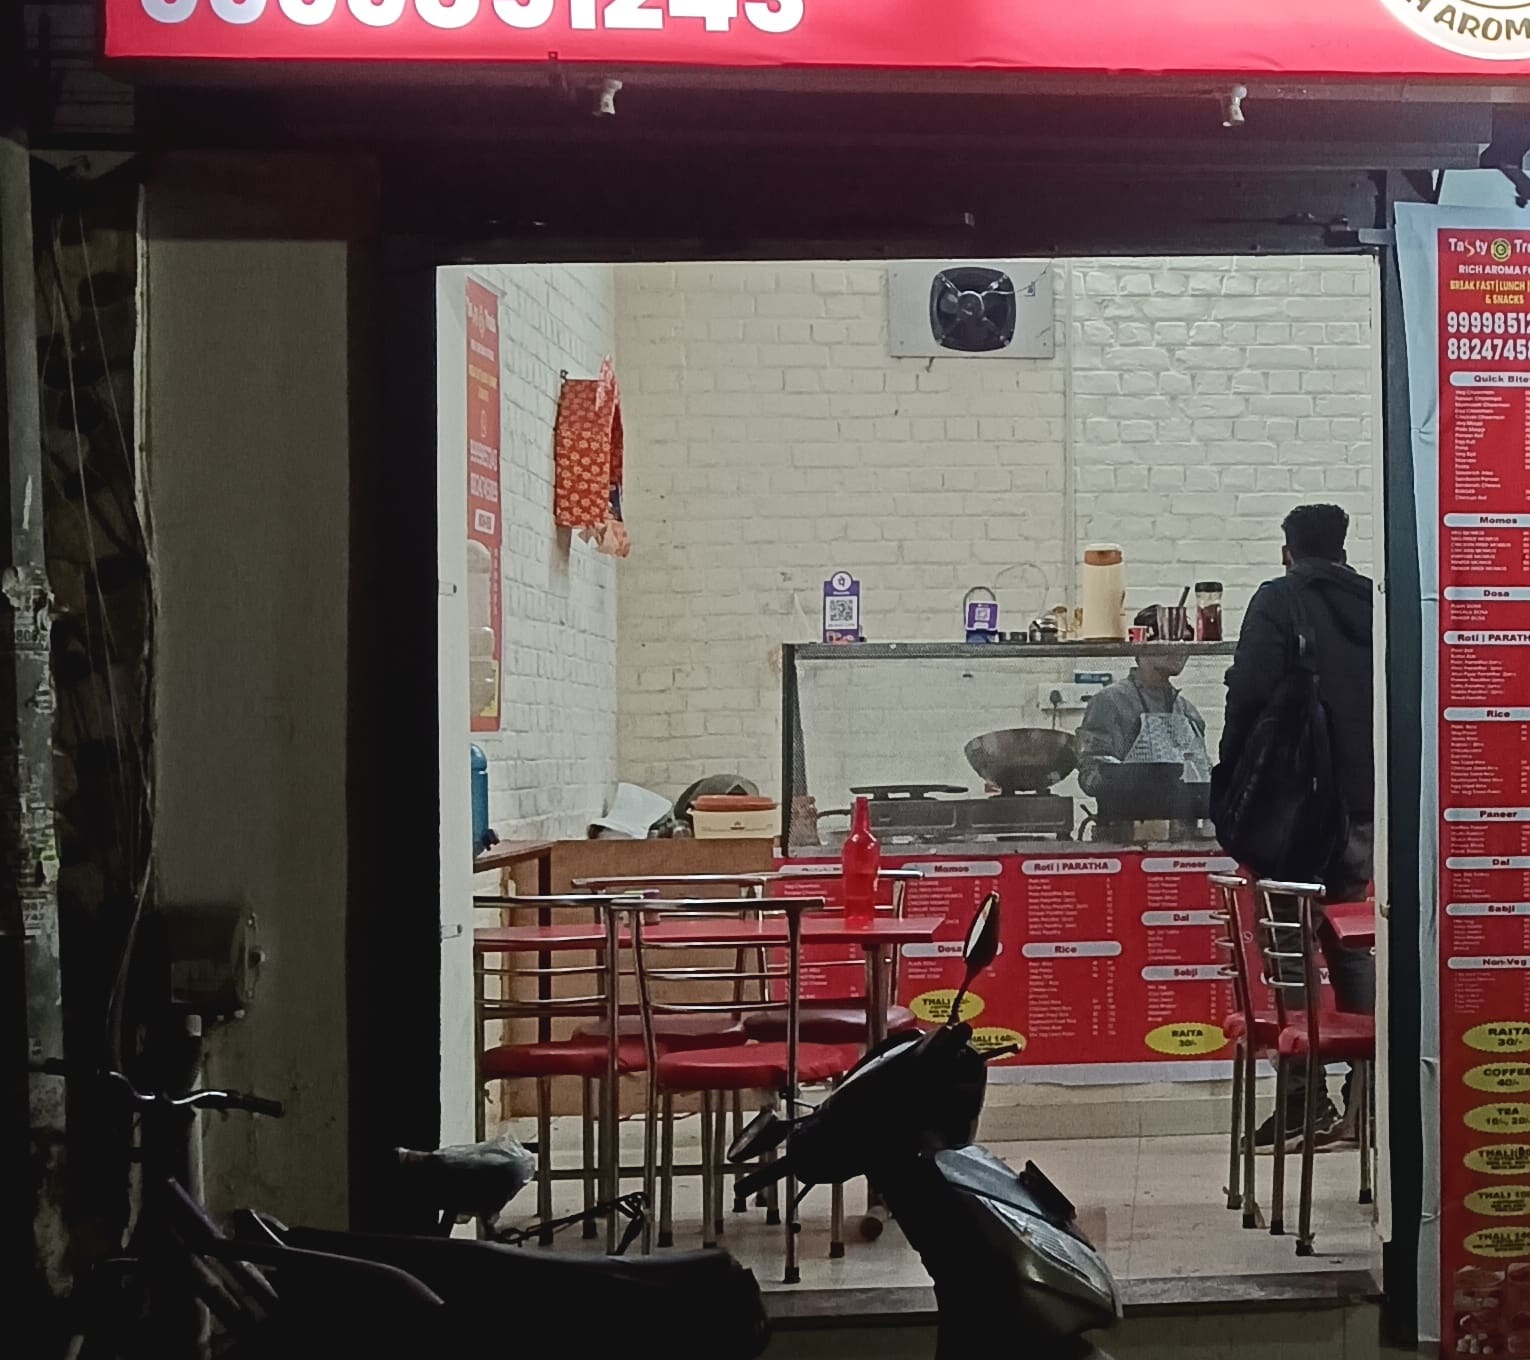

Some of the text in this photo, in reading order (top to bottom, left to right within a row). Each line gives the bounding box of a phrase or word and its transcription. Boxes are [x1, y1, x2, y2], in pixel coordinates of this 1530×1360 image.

[1459, 265, 1482, 274] RICH
[1485, 265, 1521, 275] AROMA
[1450, 281, 1475, 290] BREAK
[1493, 295, 1524, 304] SNACKS
[1474, 375, 1503, 383] Quick
[1480, 516, 1518, 524] Momos
[1457, 634, 1480, 642] Roti
[1486, 710, 1510, 718] Rice
[1062, 862, 1109, 871] PARATHA
[1497, 1107, 1520, 1116] TEA
